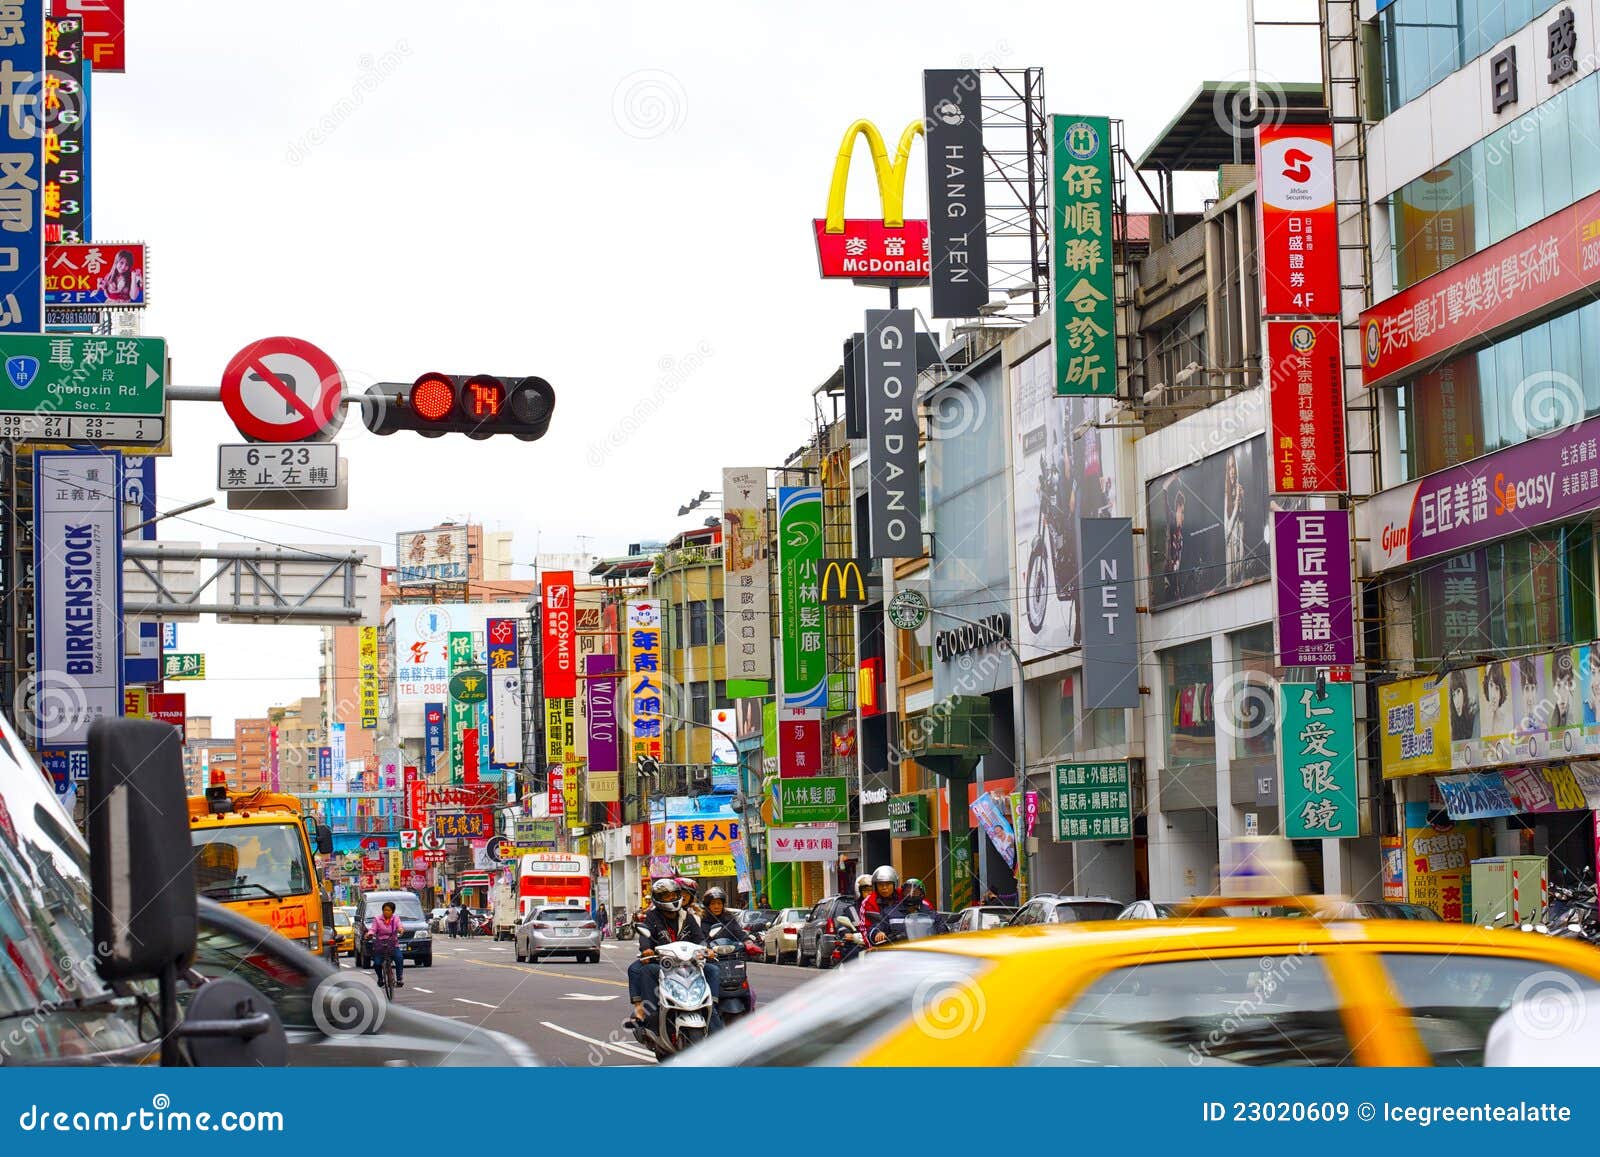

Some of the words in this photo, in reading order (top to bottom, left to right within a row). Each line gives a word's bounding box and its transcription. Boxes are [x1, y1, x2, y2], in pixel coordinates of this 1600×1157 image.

[945, 144, 967, 218] HANG
[846, 237, 929, 256] 麥當
[949, 232, 969, 283] TEN
[1289, 217, 1305, 287] 日盛證券
[1062, 163, 1109, 391] 保順聯合診所
[49, 339, 141, 365] 重新路
[47, 384, 111, 396] Chongxin
[118, 385, 140, 396] Rd.
[75, 401, 100, 410] Sec.
[104, 402, 111, 410] 2
[471, 384, 497, 414] 74
[247, 448, 311, 466] 6-23
[880, 325, 906, 542] GIORDANO
[228, 467, 329, 486] 禁止左轉
[1421, 475, 1488, 538] 巨匠美語
[1382, 522, 1407, 558] Gjun
[64, 524, 94, 676] BIRKENSTOCK
[1100, 559, 1119, 635] NET
[1296, 515, 1332, 641] 巨匠美語
[800, 558, 821, 652] 小林髮廊
[557, 611, 570, 669] COSMED
[935, 612, 1005, 663] GIORDANO
[1299, 689, 1343, 832] 仁愛眼鏡
[784, 786, 837, 805] 小林髮廊
[793, 838, 833, 850] 華歌爾
